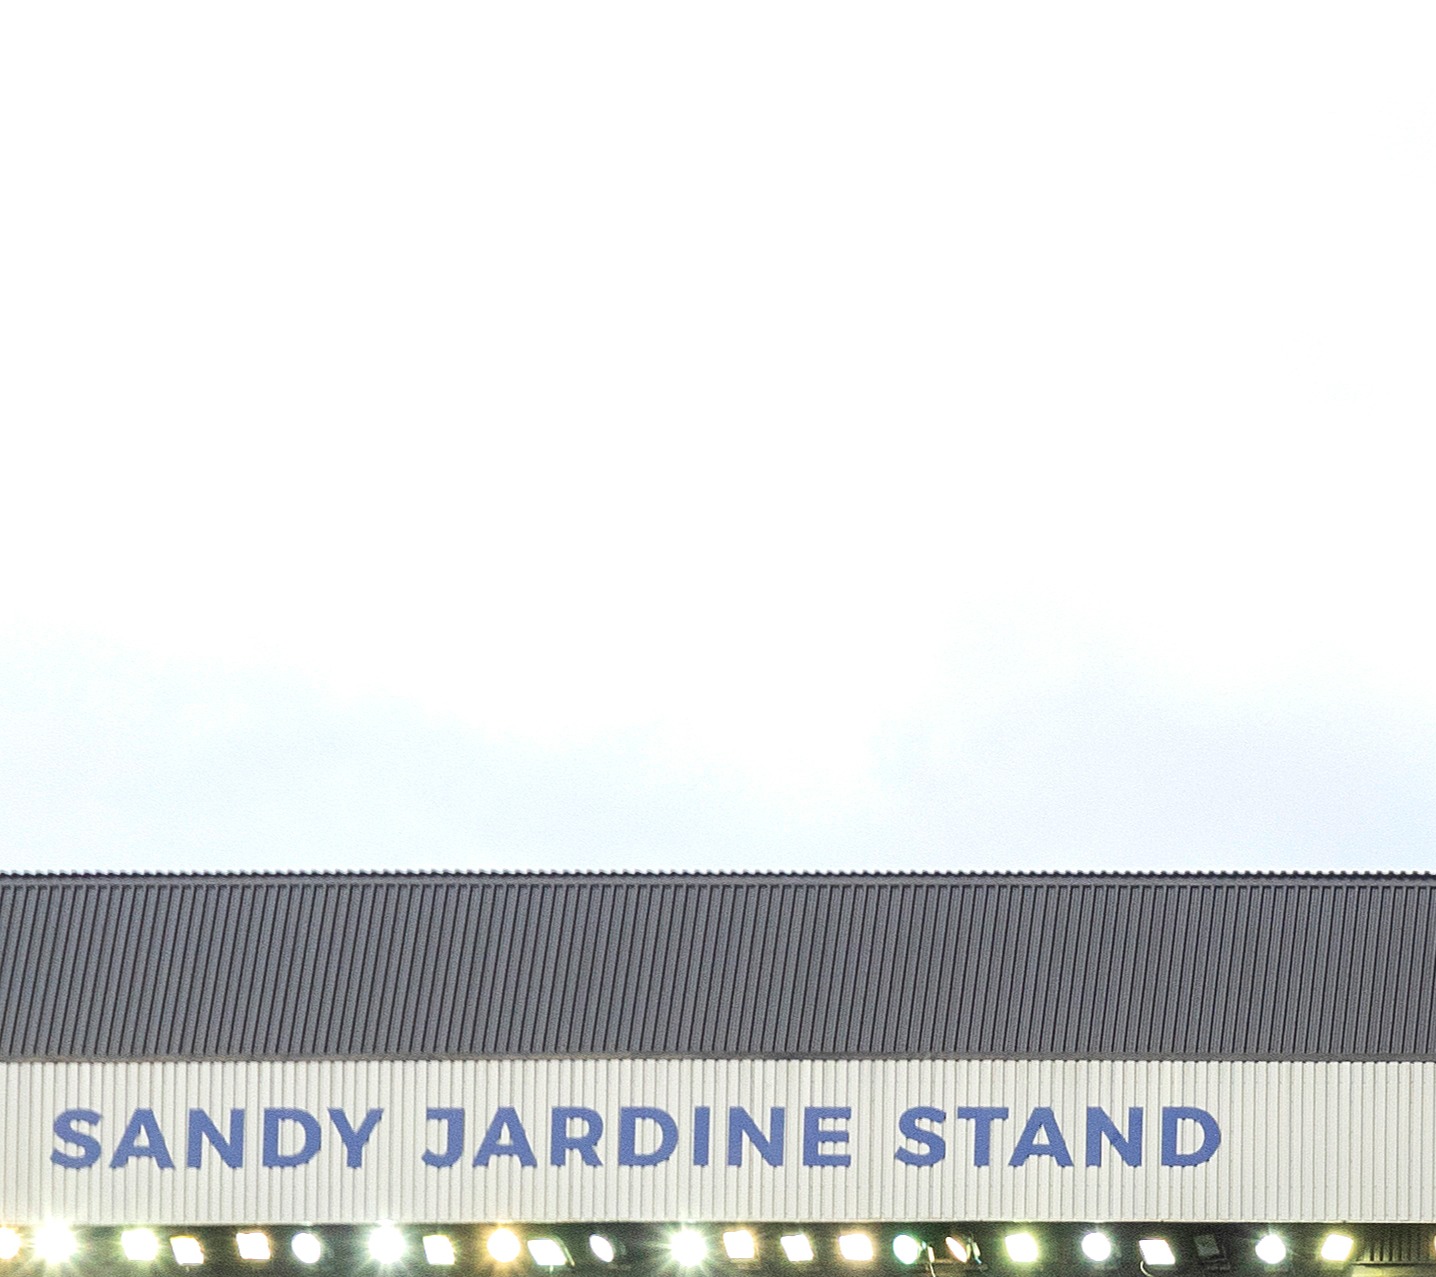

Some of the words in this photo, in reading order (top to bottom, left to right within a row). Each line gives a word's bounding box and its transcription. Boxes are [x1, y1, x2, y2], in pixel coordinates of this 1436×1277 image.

[51, 1106, 384, 1169] SANDY
[421, 1106, 851, 1168] JARDINE
[894, 1106, 1222, 1168] STAND
